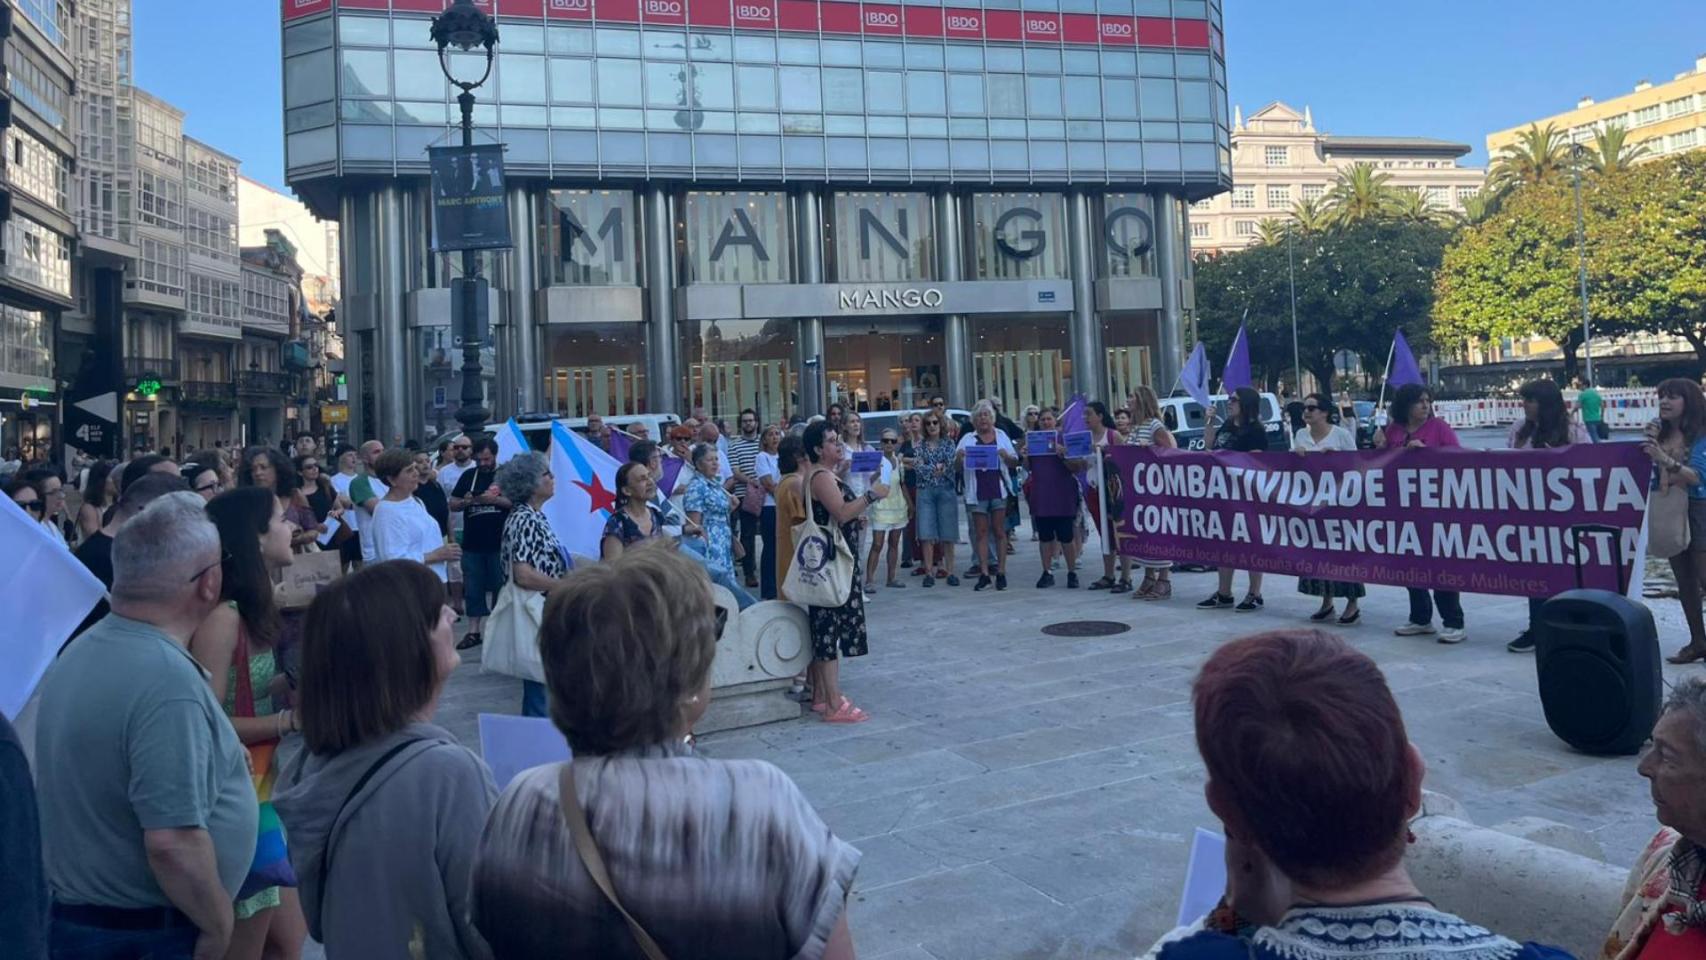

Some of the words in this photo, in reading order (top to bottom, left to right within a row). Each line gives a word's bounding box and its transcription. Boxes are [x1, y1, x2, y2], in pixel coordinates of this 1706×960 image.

[649, 2, 681, 13] BDO
[740, 5, 771, 17] BDO
[869, 13, 898, 25] BDO
[951, 16, 979, 28] BDO
[1030, 20, 1057, 31] BDO
[1104, 23, 1132, 35] BDO
[437, 197, 462, 206] MARC
[464, 195, 503, 205] ANTHONY
[839, 288, 943, 310] MANGO
[1132, 462, 1386, 508] COMBATIVIDADE
[1397, 466, 1646, 512] FEMINISTA
[1133, 504, 1225, 541] CONTRA
[1231, 512, 1252, 543] A
[1258, 514, 1424, 557] VIOLENCIA
[1431, 521, 1639, 567] MACHISTA
[1124, 540, 1194, 559] Coordenadora
[1195, 549, 1219, 562] local
[1222, 552, 1236, 564] de
[1239, 553, 1248, 565] A
[1296, 559, 1313, 573] da
[1317, 561, 1368, 578] Marcha
[1372, 565, 1433, 584] Mundial
[1437, 569, 1466, 587] das
[1471, 573, 1549, 593] Mulleres
